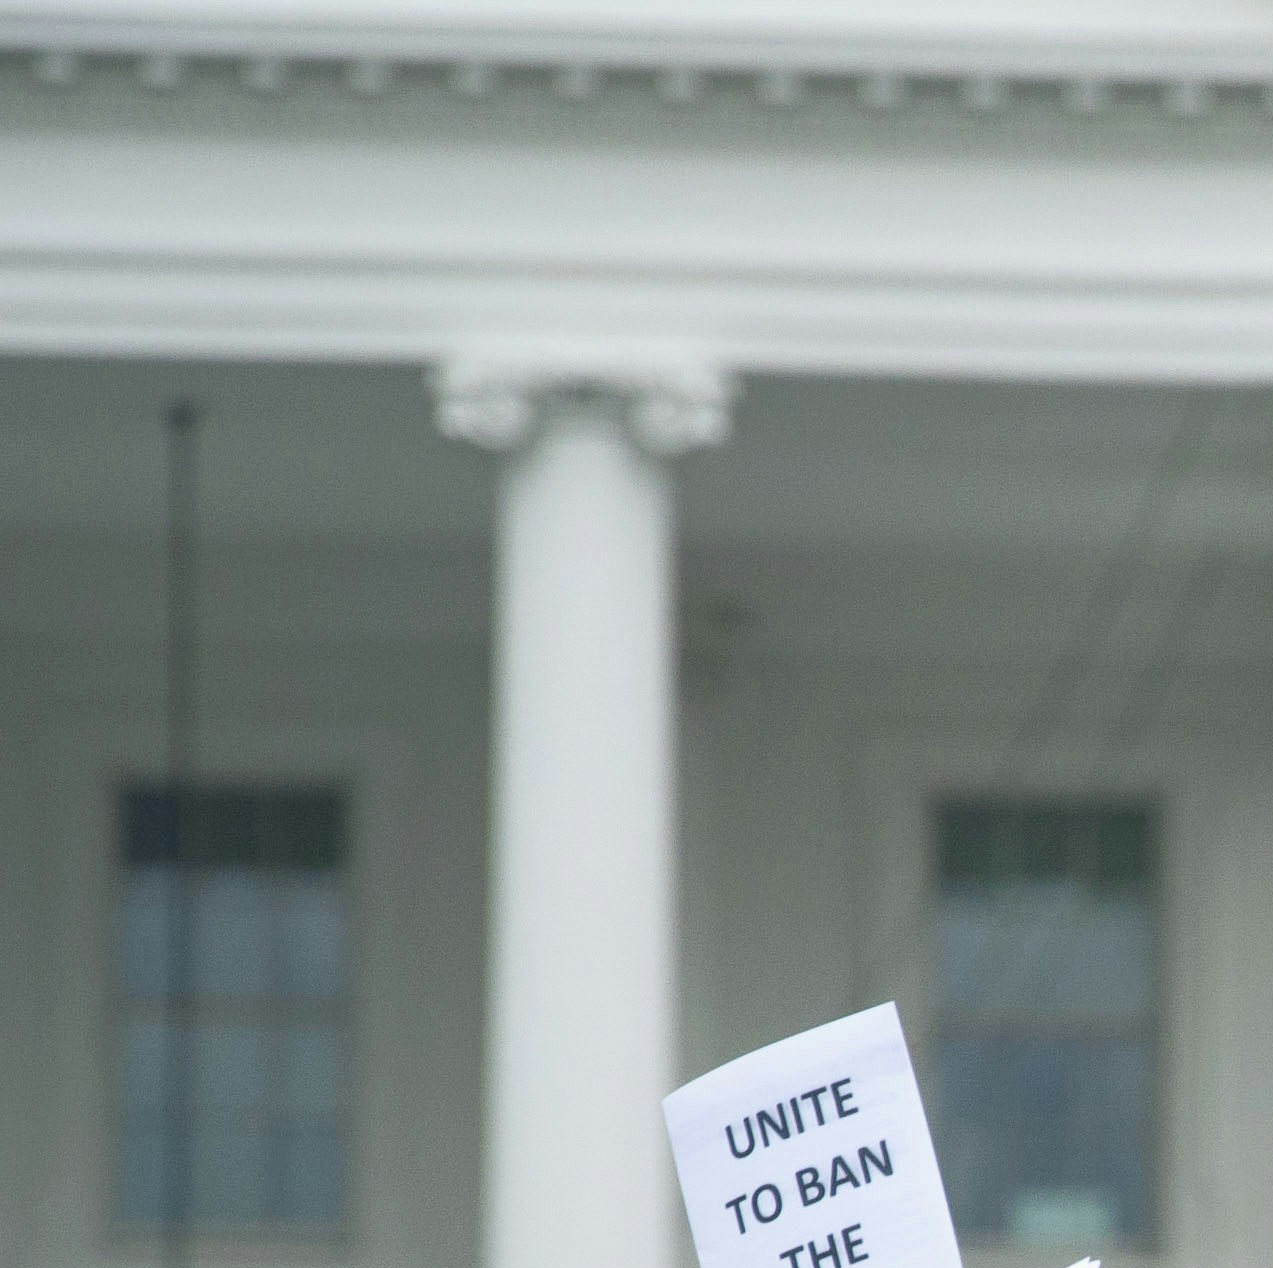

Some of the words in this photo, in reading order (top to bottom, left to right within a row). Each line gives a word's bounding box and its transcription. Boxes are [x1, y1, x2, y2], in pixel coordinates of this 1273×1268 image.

[723, 1077, 859, 1160] UNITE
[724, 1182, 784, 1236] TO
[794, 1139, 894, 1208] BAN
